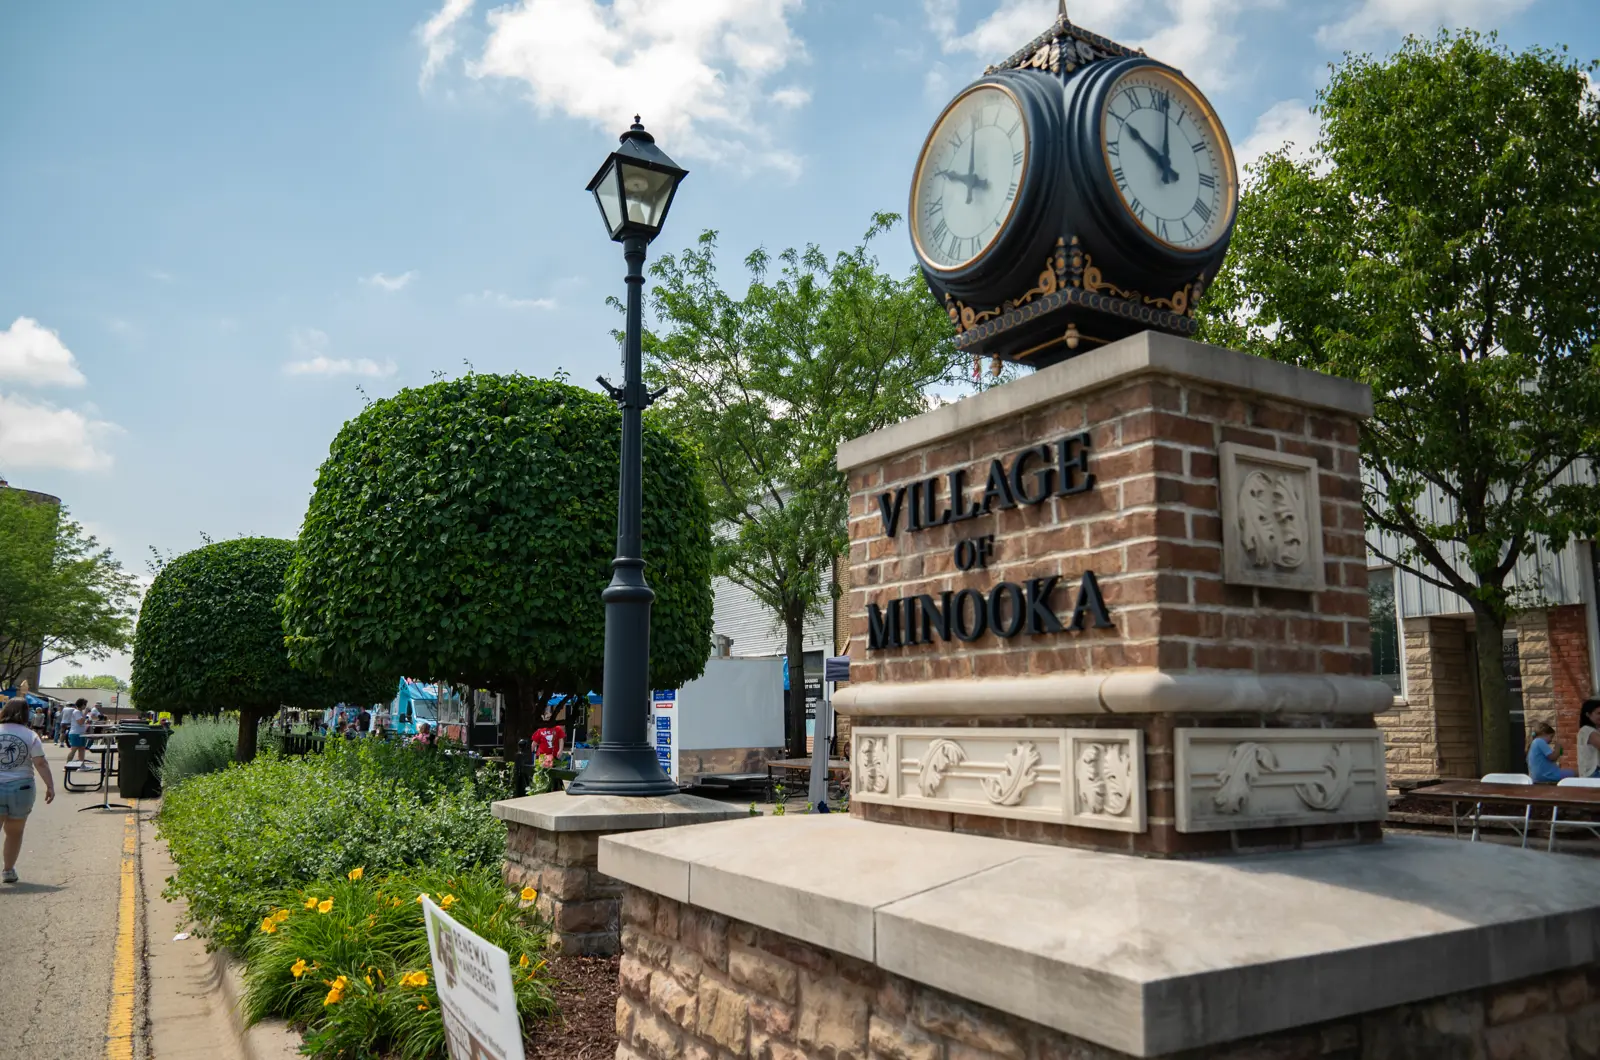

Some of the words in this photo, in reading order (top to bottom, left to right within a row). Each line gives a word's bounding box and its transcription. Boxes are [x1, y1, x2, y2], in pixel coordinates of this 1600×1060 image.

[878, 432, 1096, 538] VILLAGE
[954, 534, 995, 571] OF
[865, 570, 1116, 651] MINOOKA
